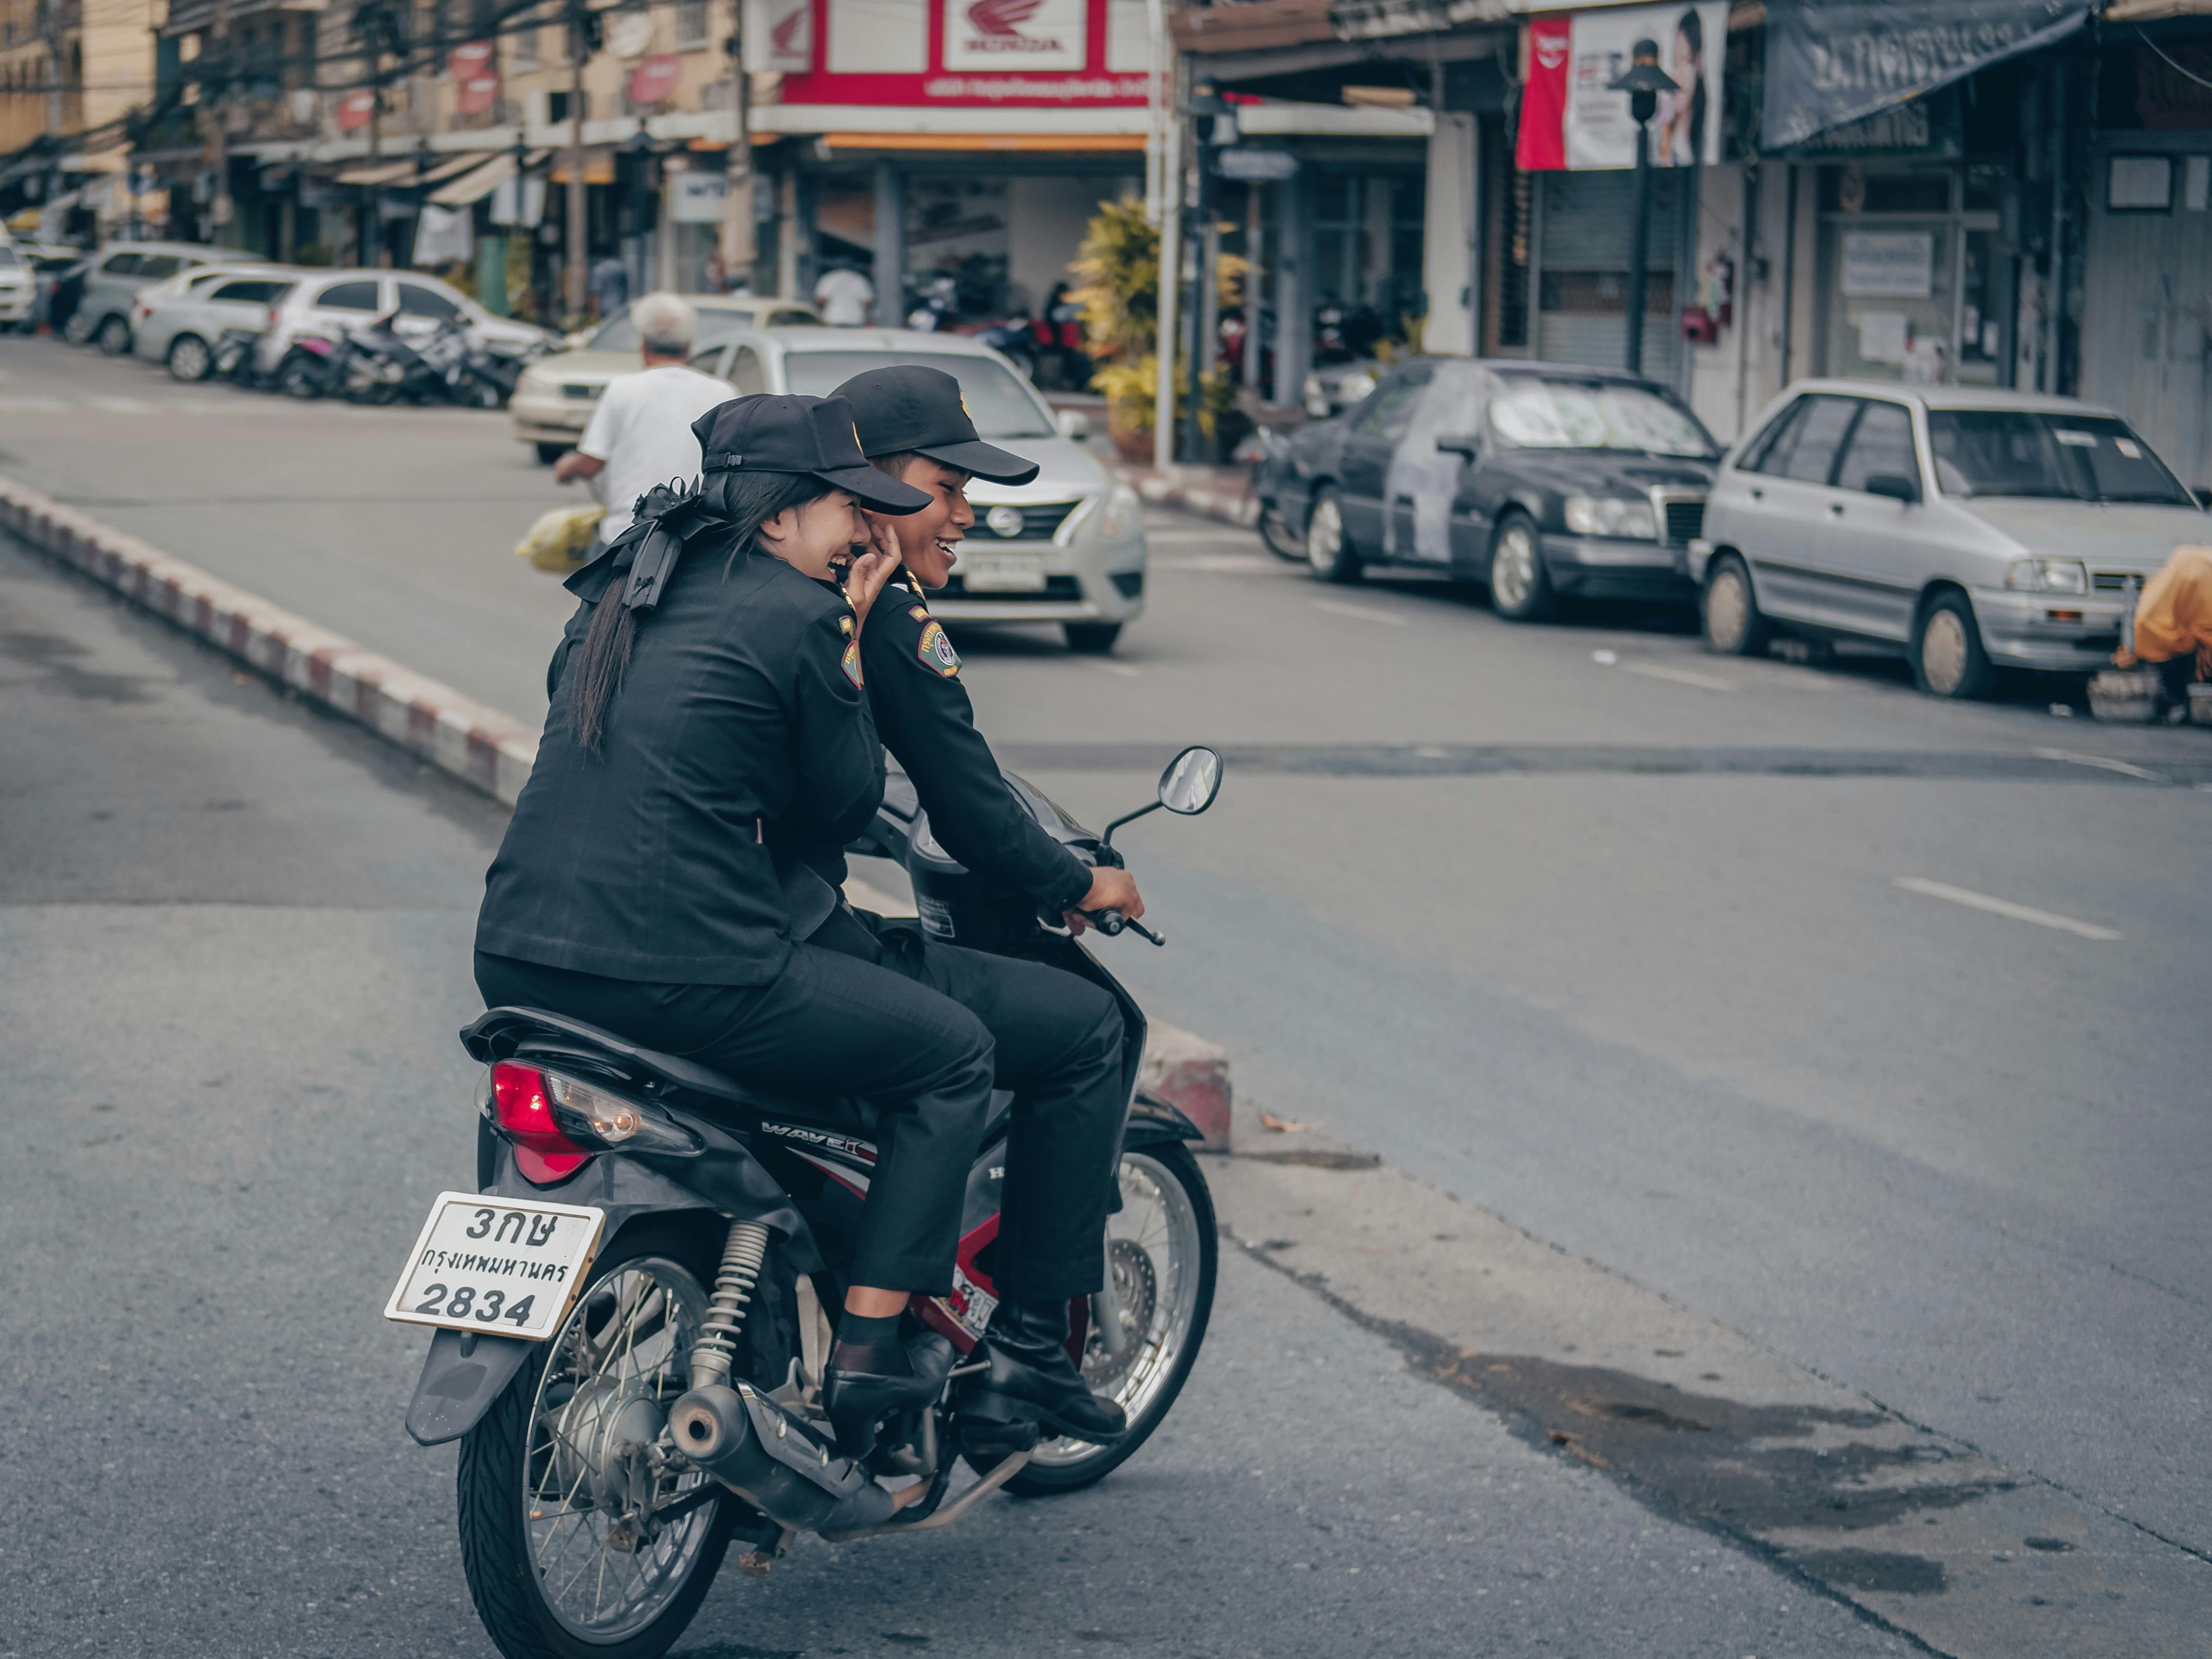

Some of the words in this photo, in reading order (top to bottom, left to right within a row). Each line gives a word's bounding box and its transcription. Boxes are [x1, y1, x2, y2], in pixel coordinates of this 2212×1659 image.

[761, 1121, 845, 1150] WAVE
[466, 1209, 558, 1246] 3กษ
[421, 1249, 568, 1282] กรุงเทพมหานคร
[415, 1283, 535, 1326] 2834
